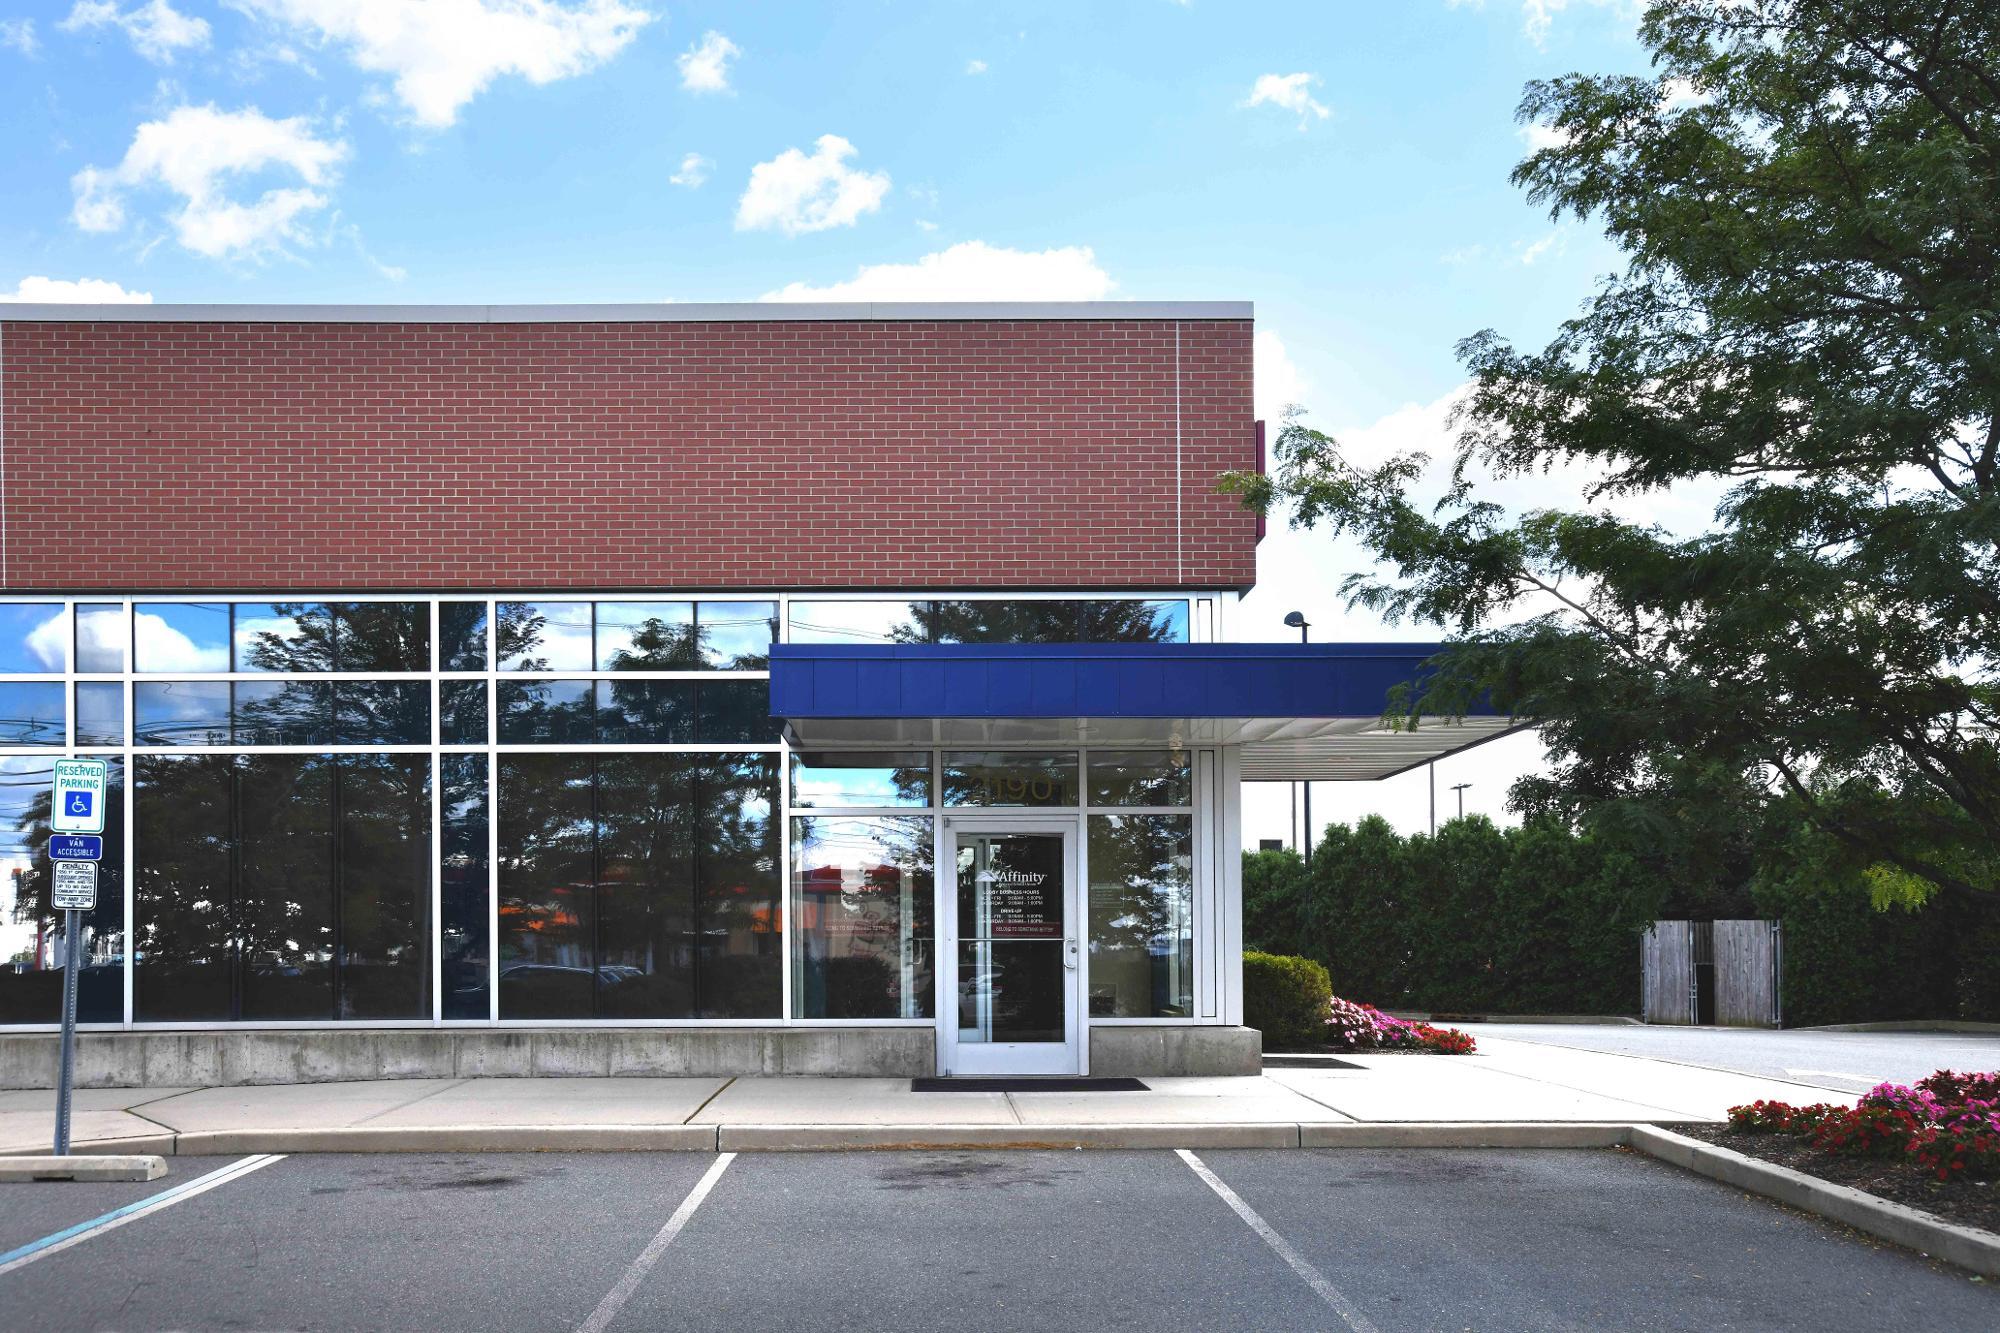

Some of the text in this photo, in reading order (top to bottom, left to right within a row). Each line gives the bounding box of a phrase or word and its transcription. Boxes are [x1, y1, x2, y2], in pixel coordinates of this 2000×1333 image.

[58, 765, 102, 777] RESERVED
[60, 779, 99, 789] PARKING
[69, 839, 84, 847] VAN
[57, 848, 94, 856] ACCESSIBLE
[999, 871, 1045, 885] Affinity
